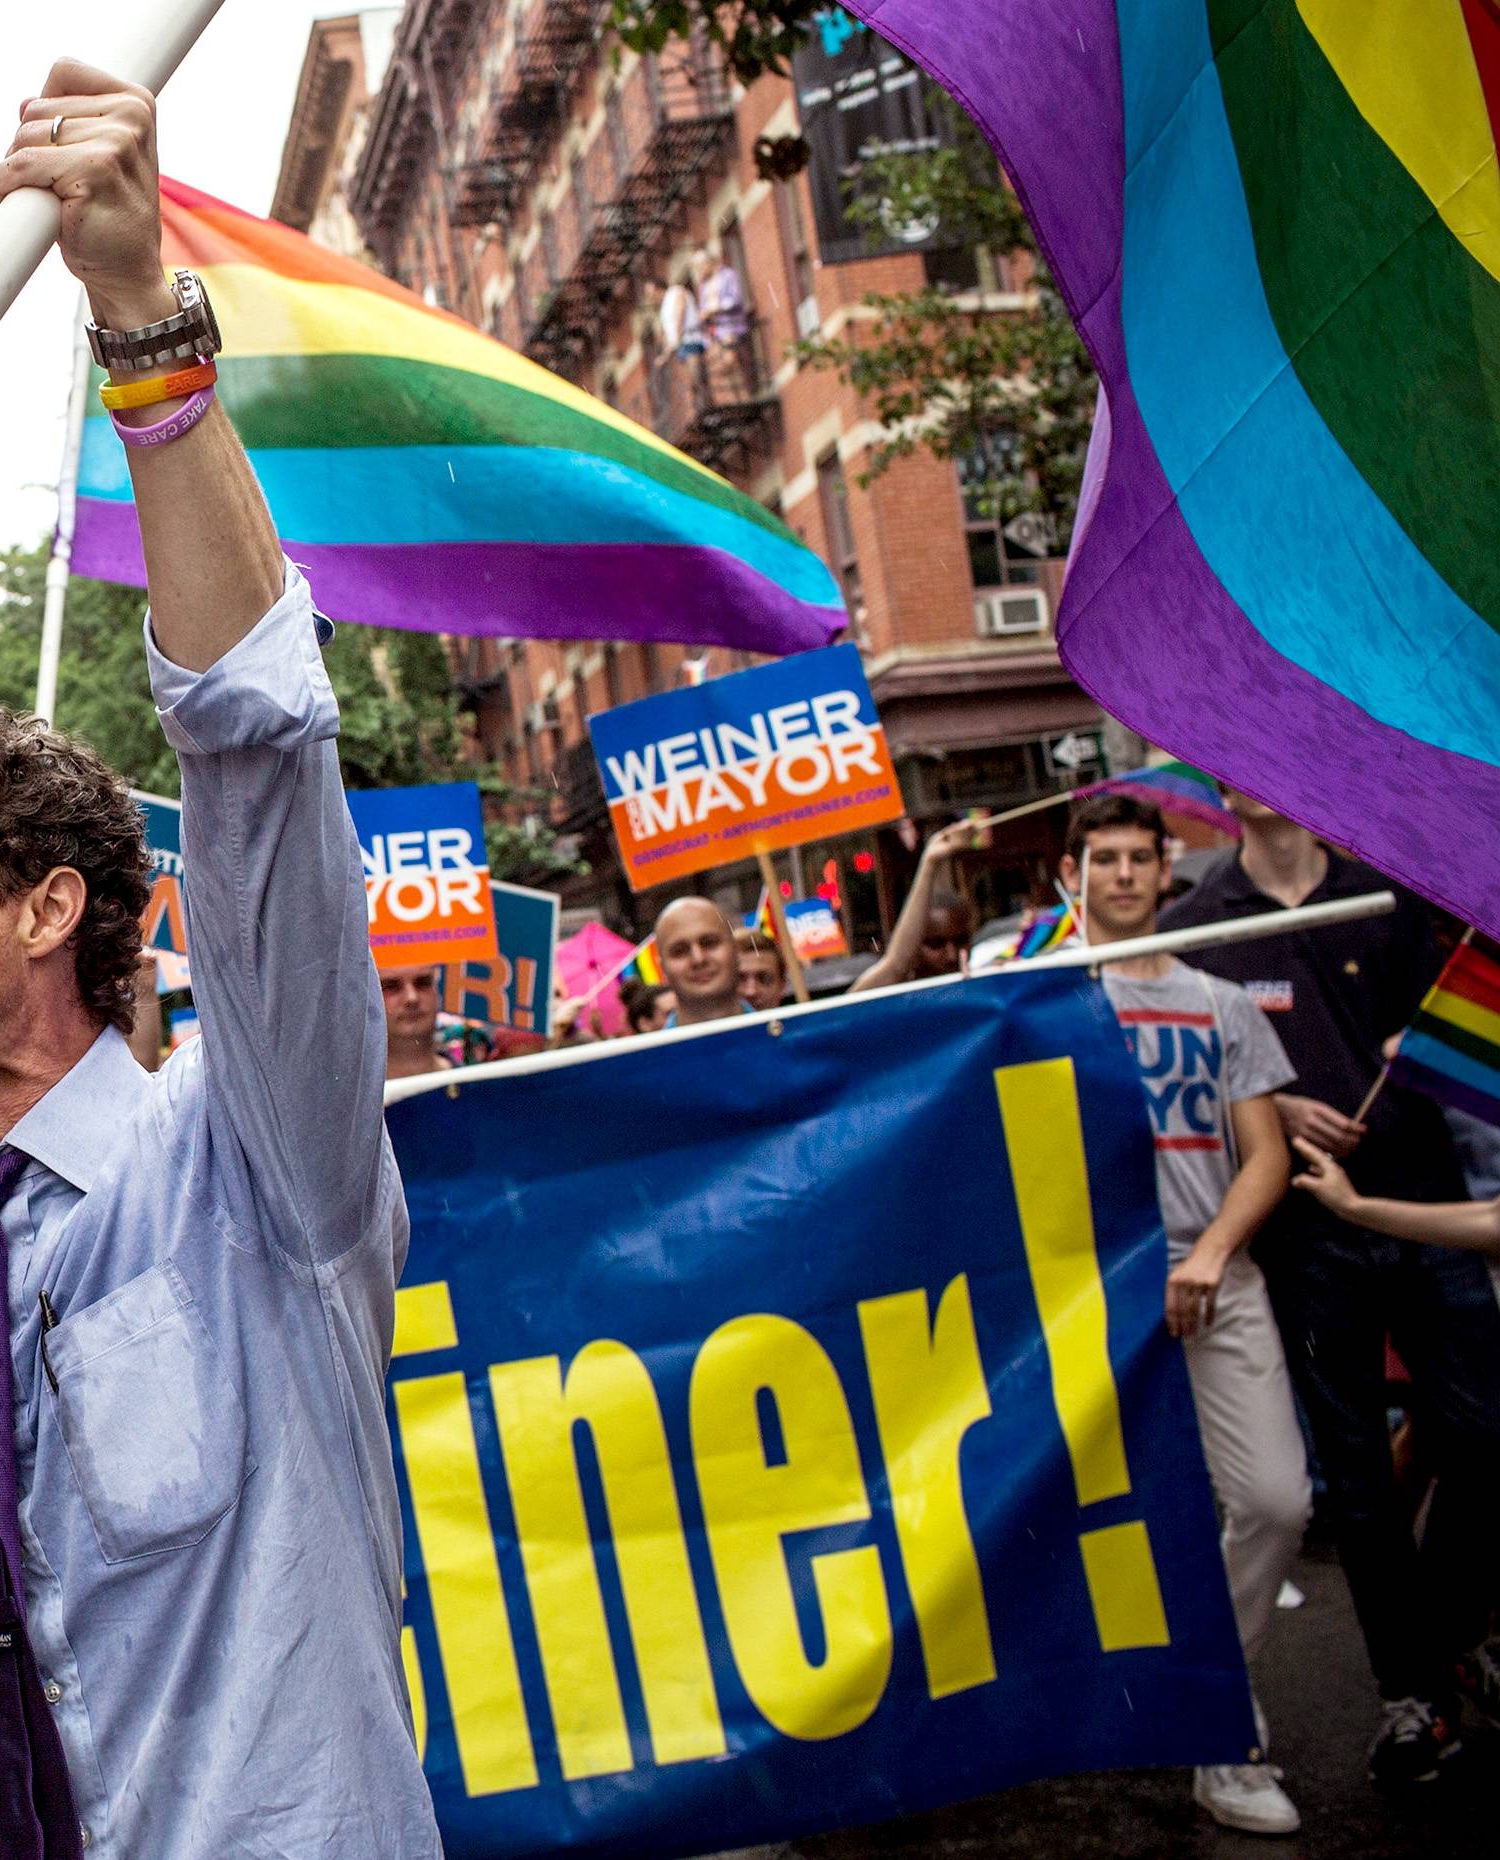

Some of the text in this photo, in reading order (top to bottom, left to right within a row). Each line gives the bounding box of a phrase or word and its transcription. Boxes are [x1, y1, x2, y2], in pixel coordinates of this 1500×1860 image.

[164, 373, 201, 394] CARE
[138, 398, 208, 446] TAKE CARE
[606, 690, 868, 797] WEINER
[641, 733, 884, 838] MAYOR
[360, 827, 476, 876] NER
[365, 872, 485, 923] YOR
[1134, 1026, 1222, 1078] UN
[1142, 1080, 1219, 1134] YC
[393, 1055, 1171, 1799] iner!
